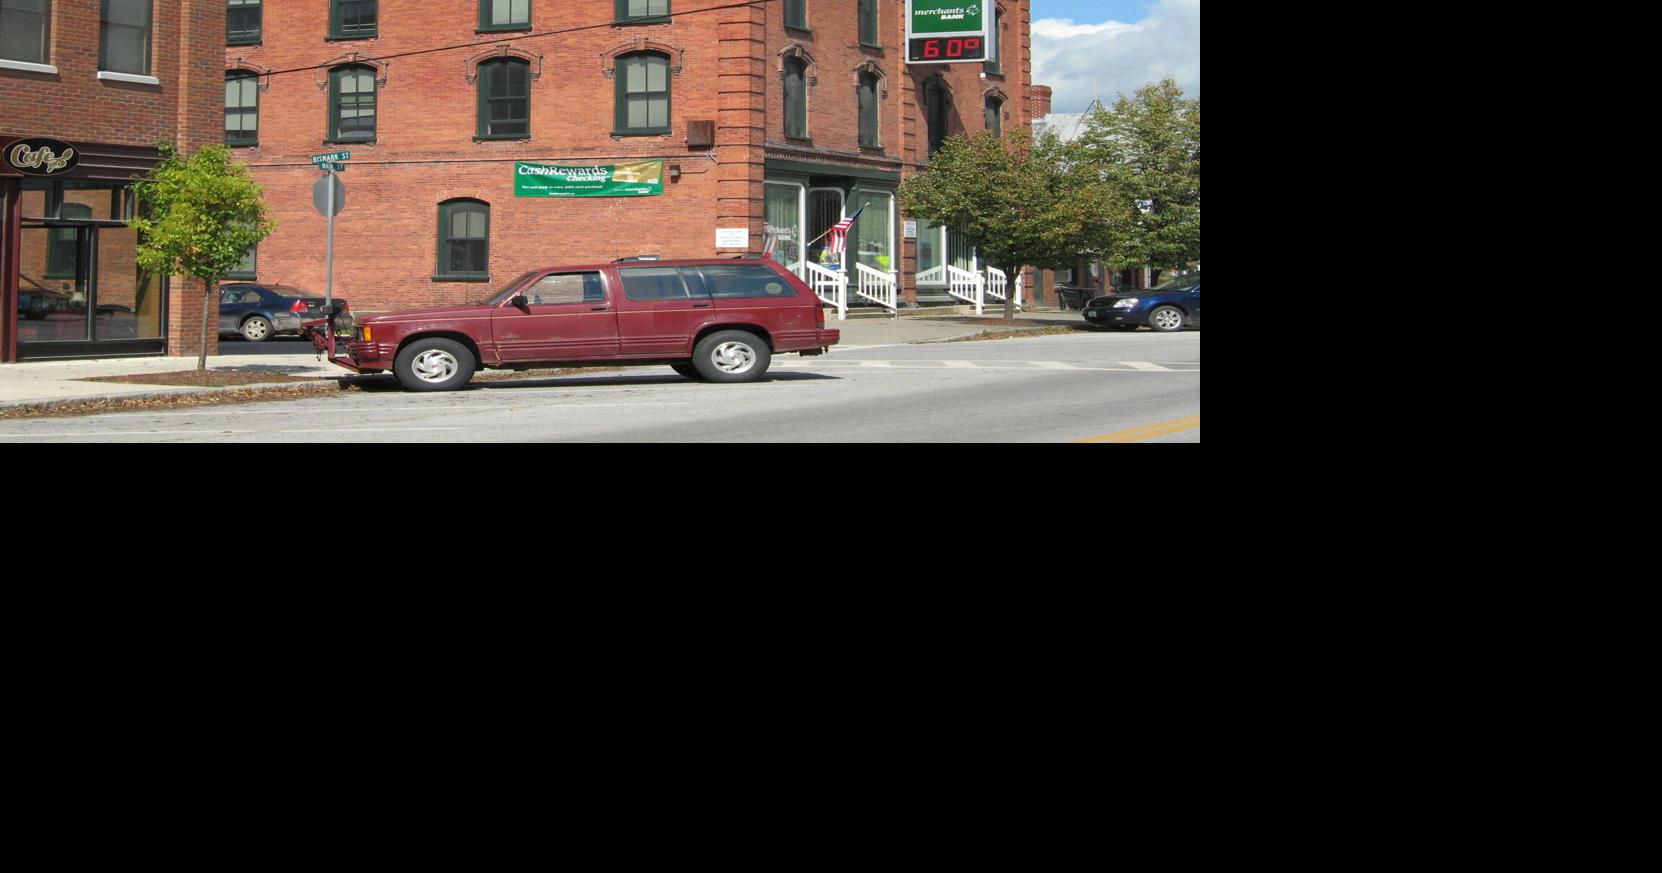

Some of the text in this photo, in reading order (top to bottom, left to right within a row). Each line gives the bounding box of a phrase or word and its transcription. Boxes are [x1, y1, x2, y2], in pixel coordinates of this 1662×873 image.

[914, 7, 965, 16] merchants
[341, 152, 349, 160] ST
[518, 164, 608, 176] CashRewards
[566, 174, 606, 183] Checking
